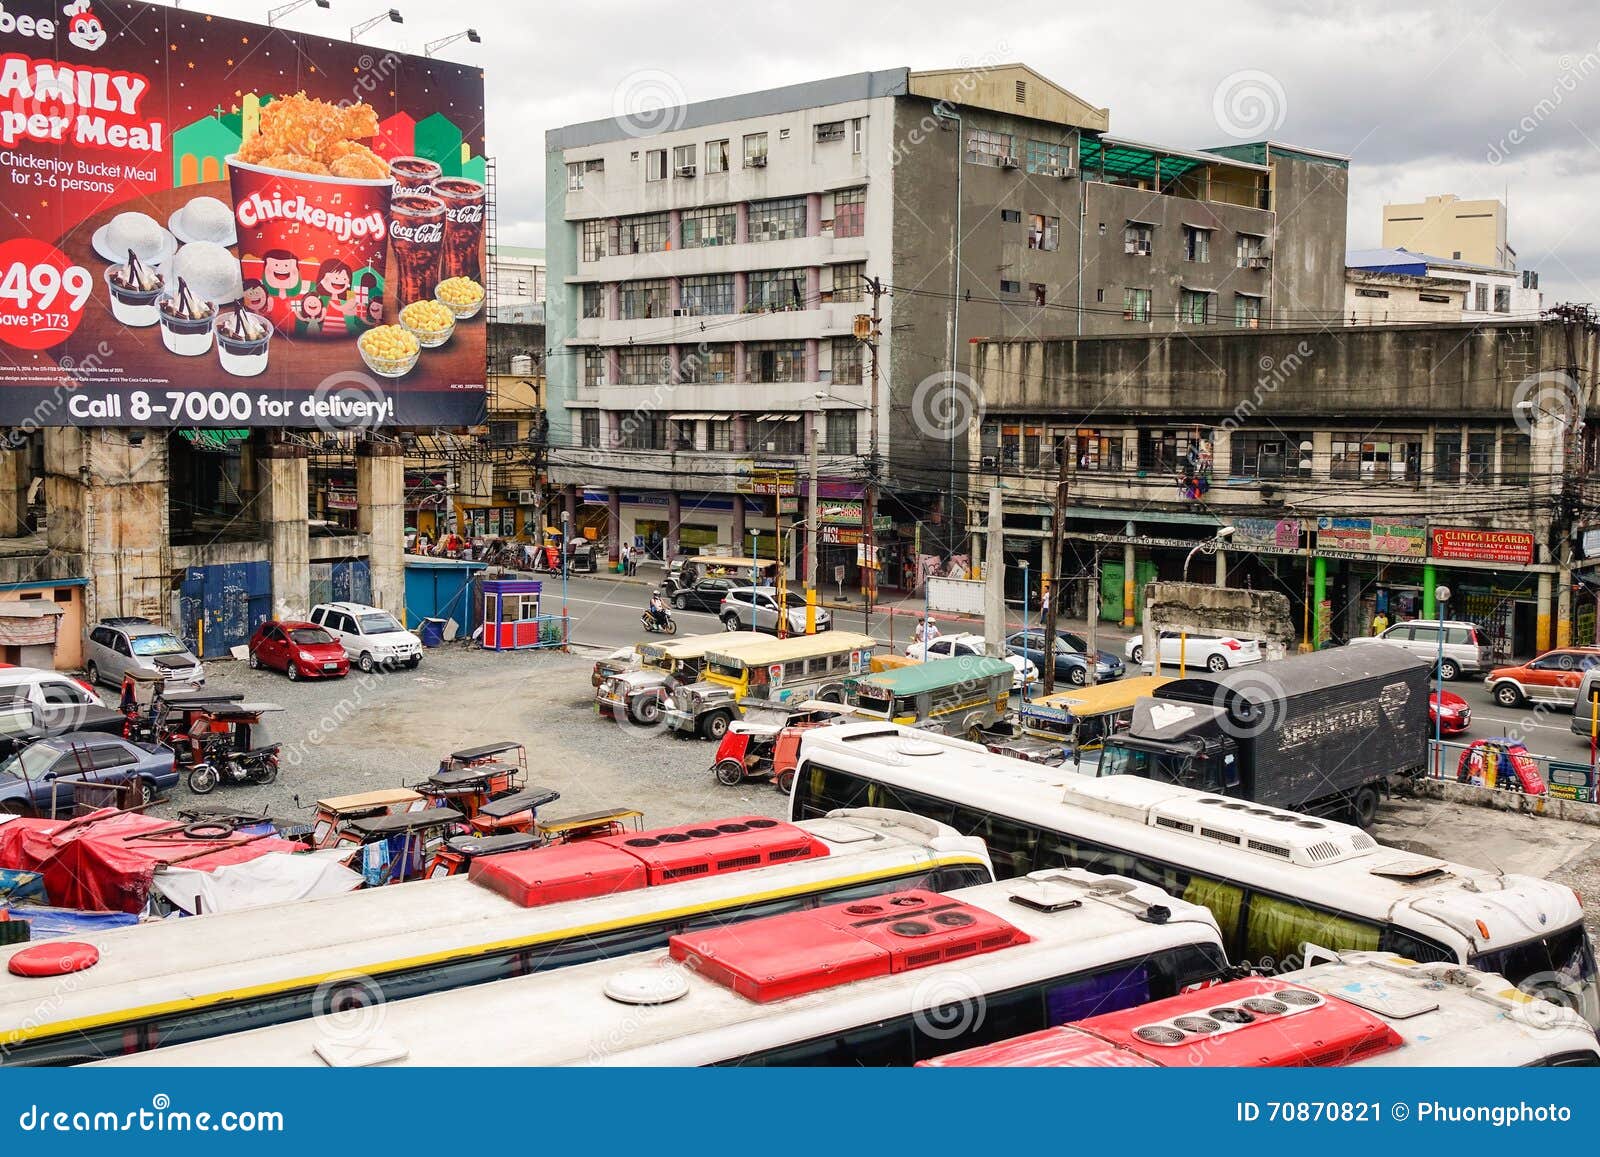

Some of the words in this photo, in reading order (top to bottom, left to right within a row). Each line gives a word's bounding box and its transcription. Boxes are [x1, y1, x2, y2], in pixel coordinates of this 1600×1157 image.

[0, 58, 146, 115] AMILY
[76, 115, 163, 152] Meal
[0, 152, 73, 173] Chickenjoy
[77, 158, 121, 178] Bucket
[124, 163, 157, 182] Meal
[11, 170, 30, 185] for
[34, 173, 57, 188] 3-6
[61, 177, 115, 194] persons
[238, 192, 385, 241] Chickenjoy
[390, 220, 443, 243] Coca-Cola
[0, 261, 93, 312] 499
[69, 394, 121, 417] Call
[130, 391, 251, 420] 8-7000
[257, 395, 294, 417] for
[300, 395, 394, 422] delivery!
[1445, 532, 1483, 542] CLINICA
[1486, 534, 1530, 544] LEGARDA
[1447, 541, 1503, 549] MULTISPECIALTY
